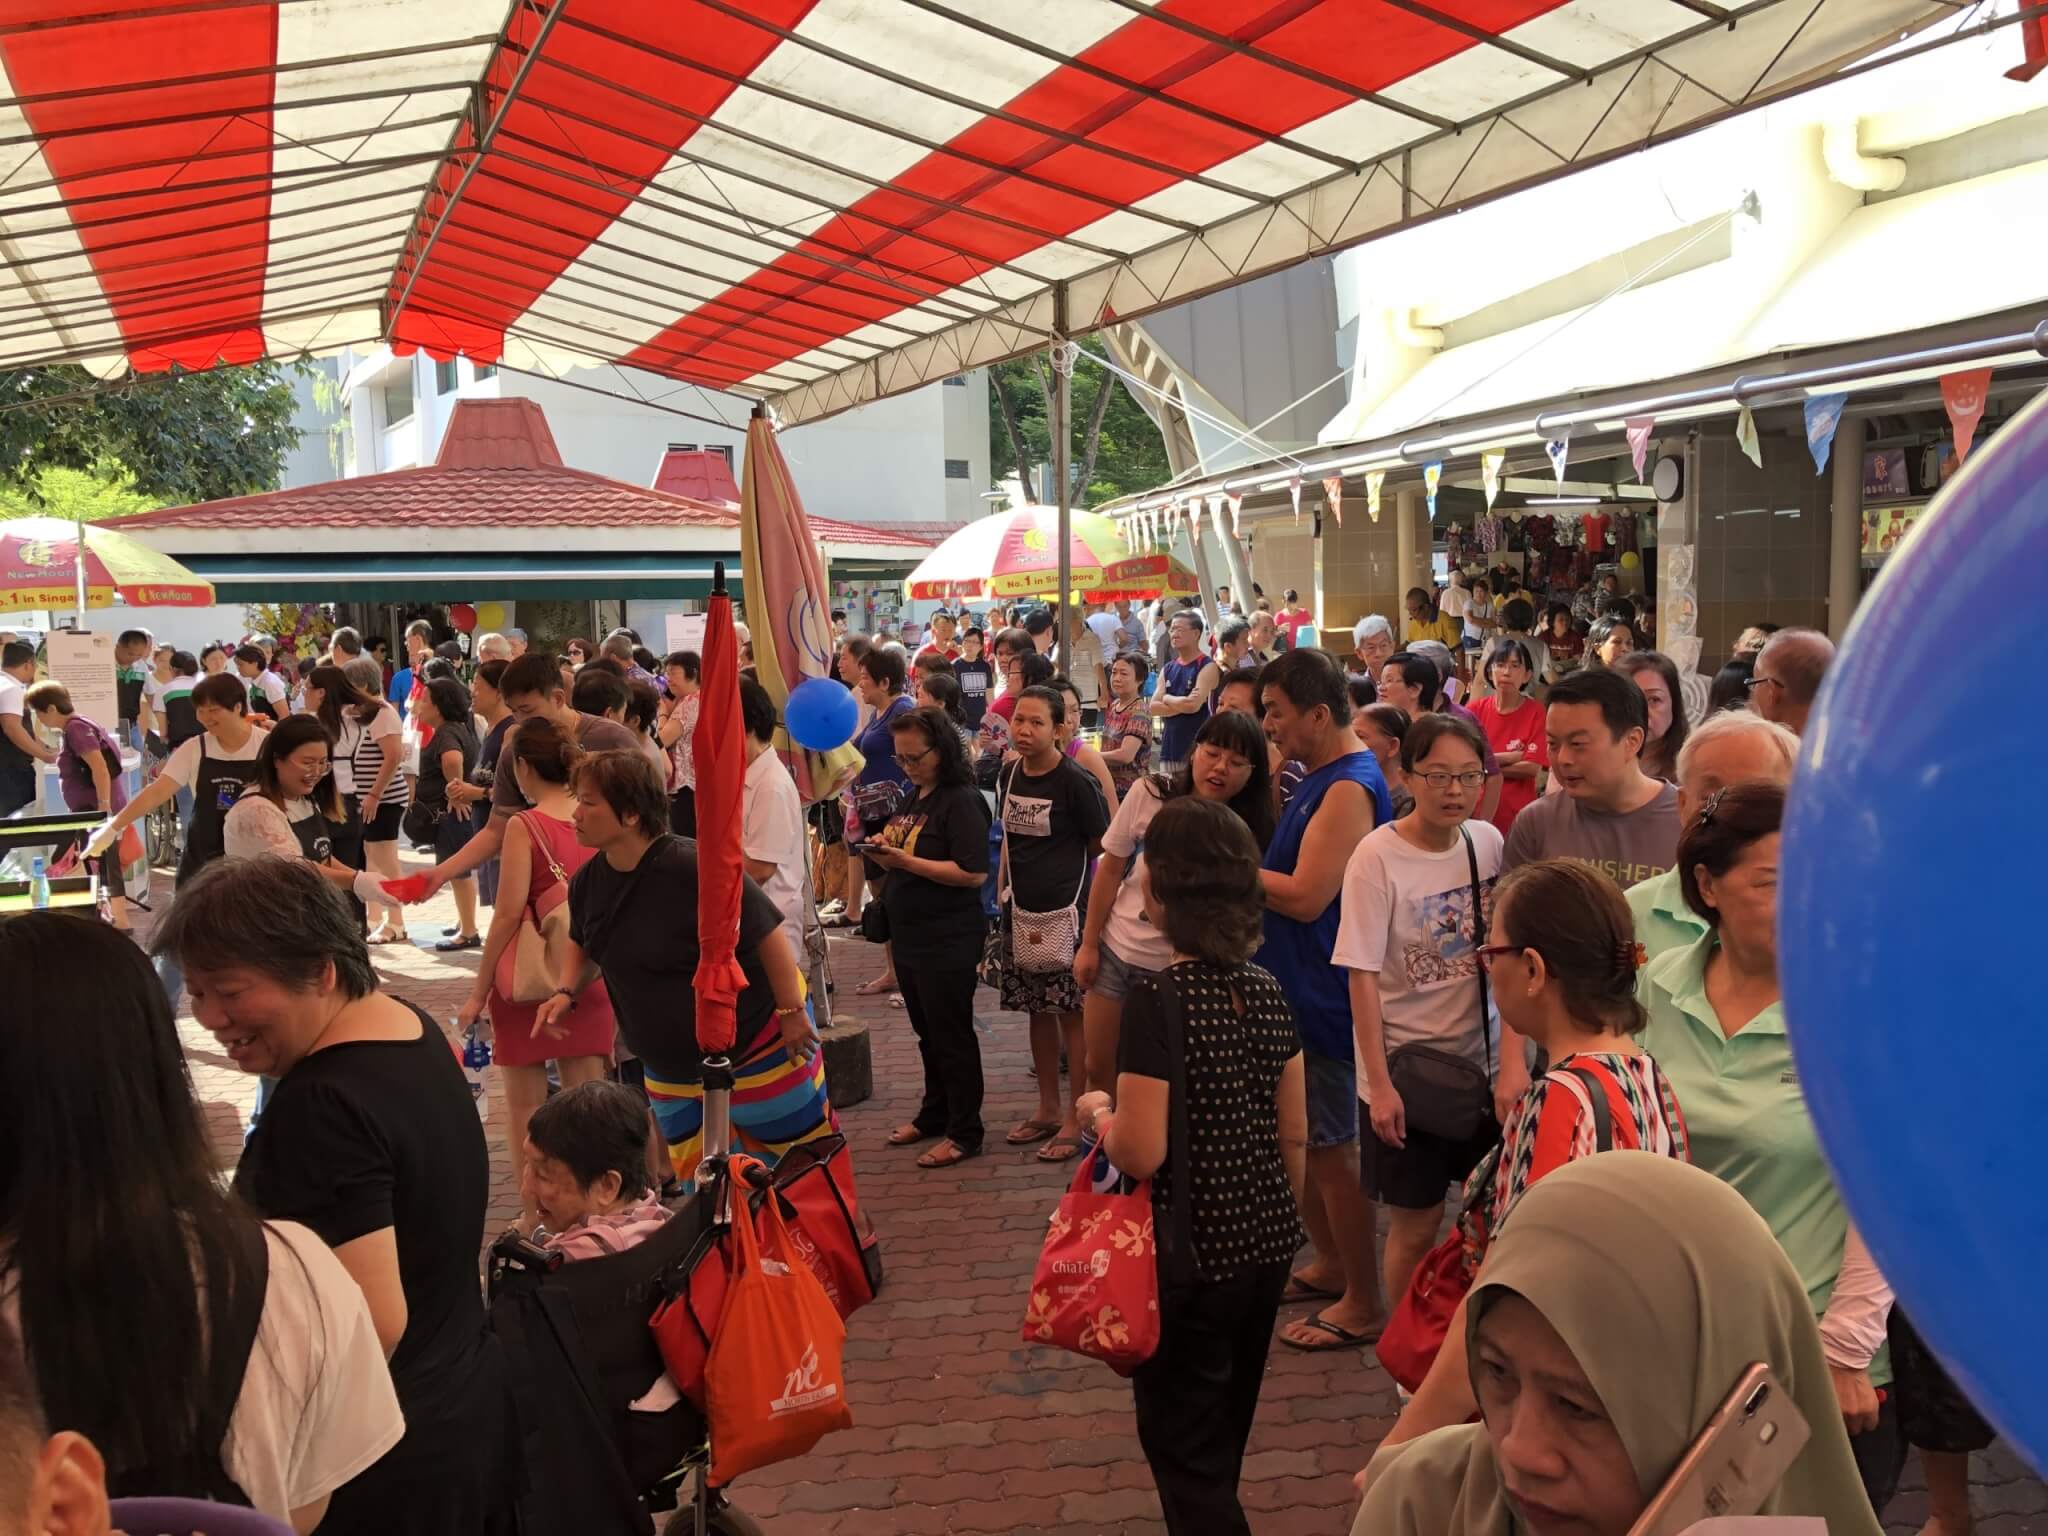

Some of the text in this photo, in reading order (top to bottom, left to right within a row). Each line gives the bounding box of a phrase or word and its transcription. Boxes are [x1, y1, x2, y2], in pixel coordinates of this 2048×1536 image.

[1024, 576, 1031, 586] 1
[1034, 577, 1043, 585] in
[10, 592, 18, 604] 1
[23, 592, 35, 603] in
[39, 593, 103, 603] Singare
